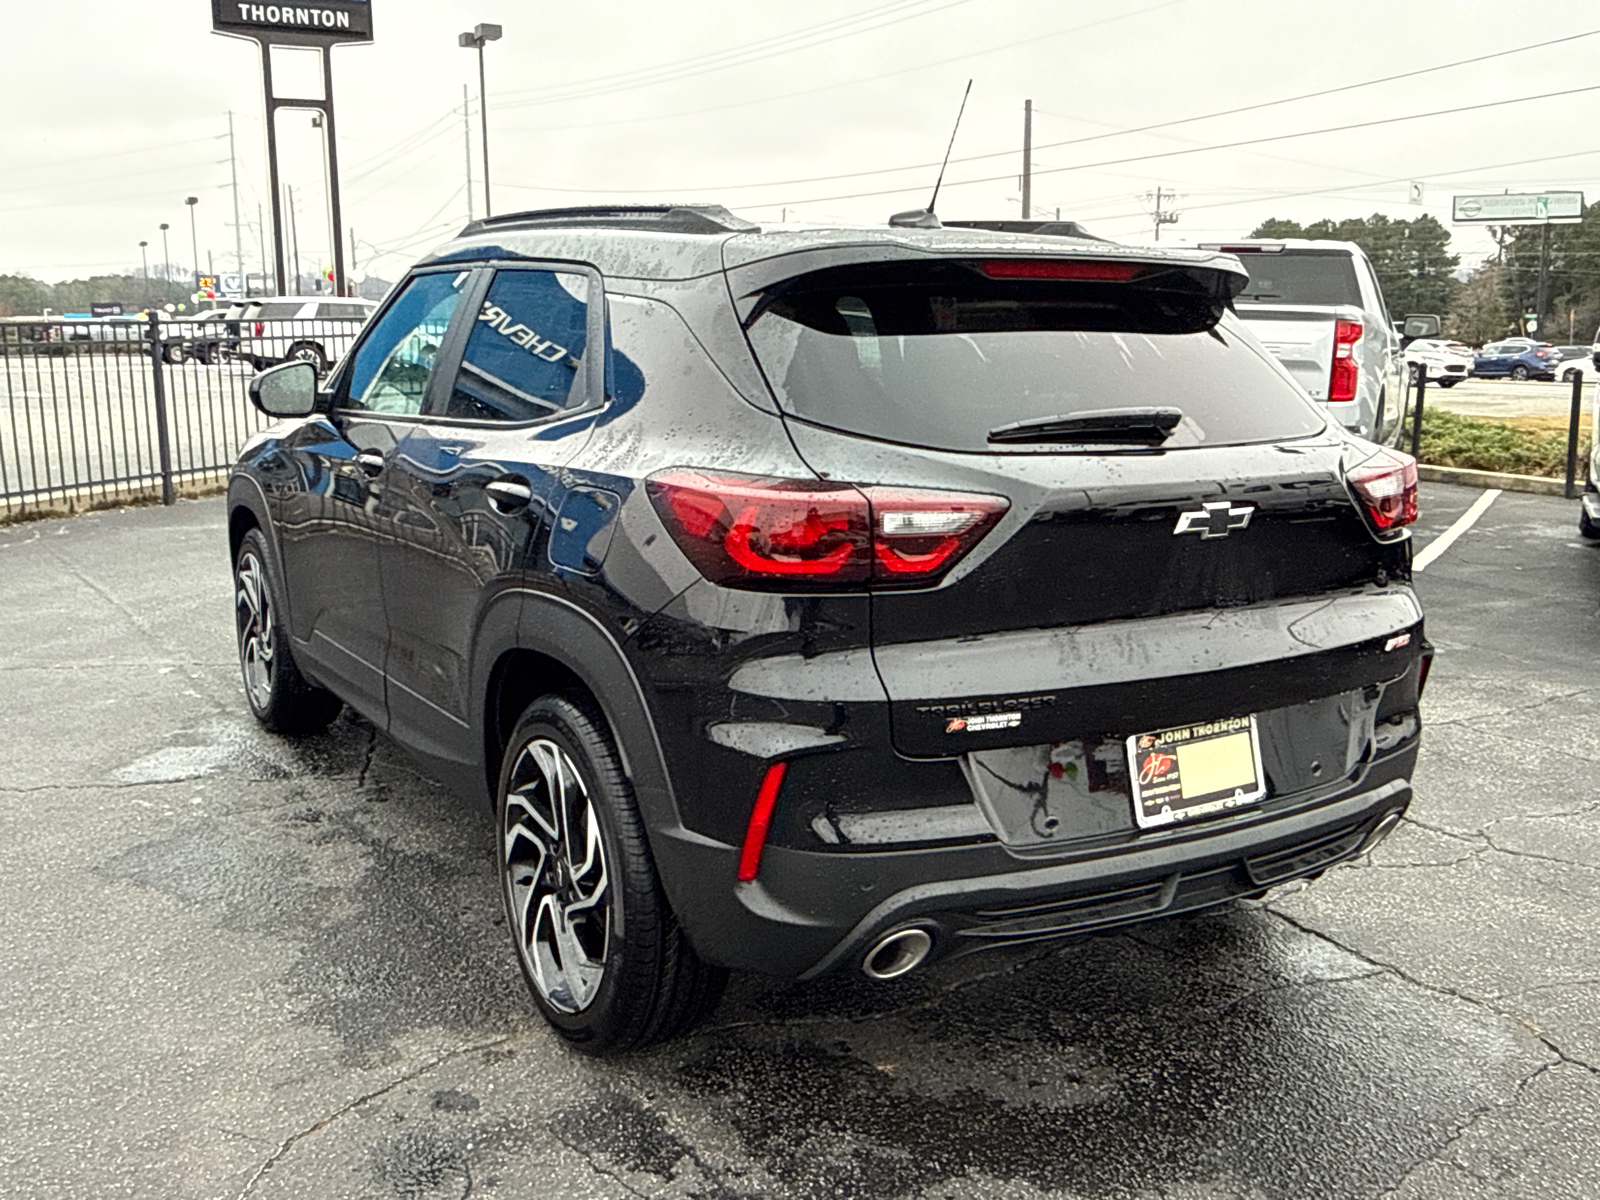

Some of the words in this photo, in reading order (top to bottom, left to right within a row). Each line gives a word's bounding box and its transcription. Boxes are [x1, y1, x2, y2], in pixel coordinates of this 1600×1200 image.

[238, 3, 349, 28] THORNTON
[986, 711, 1022, 723] THORNTON
[966, 721, 1008, 732] CHEVROLET
[1160, 728, 1190, 744] JOHN
[1192, 717, 1250, 738] THORNTON
